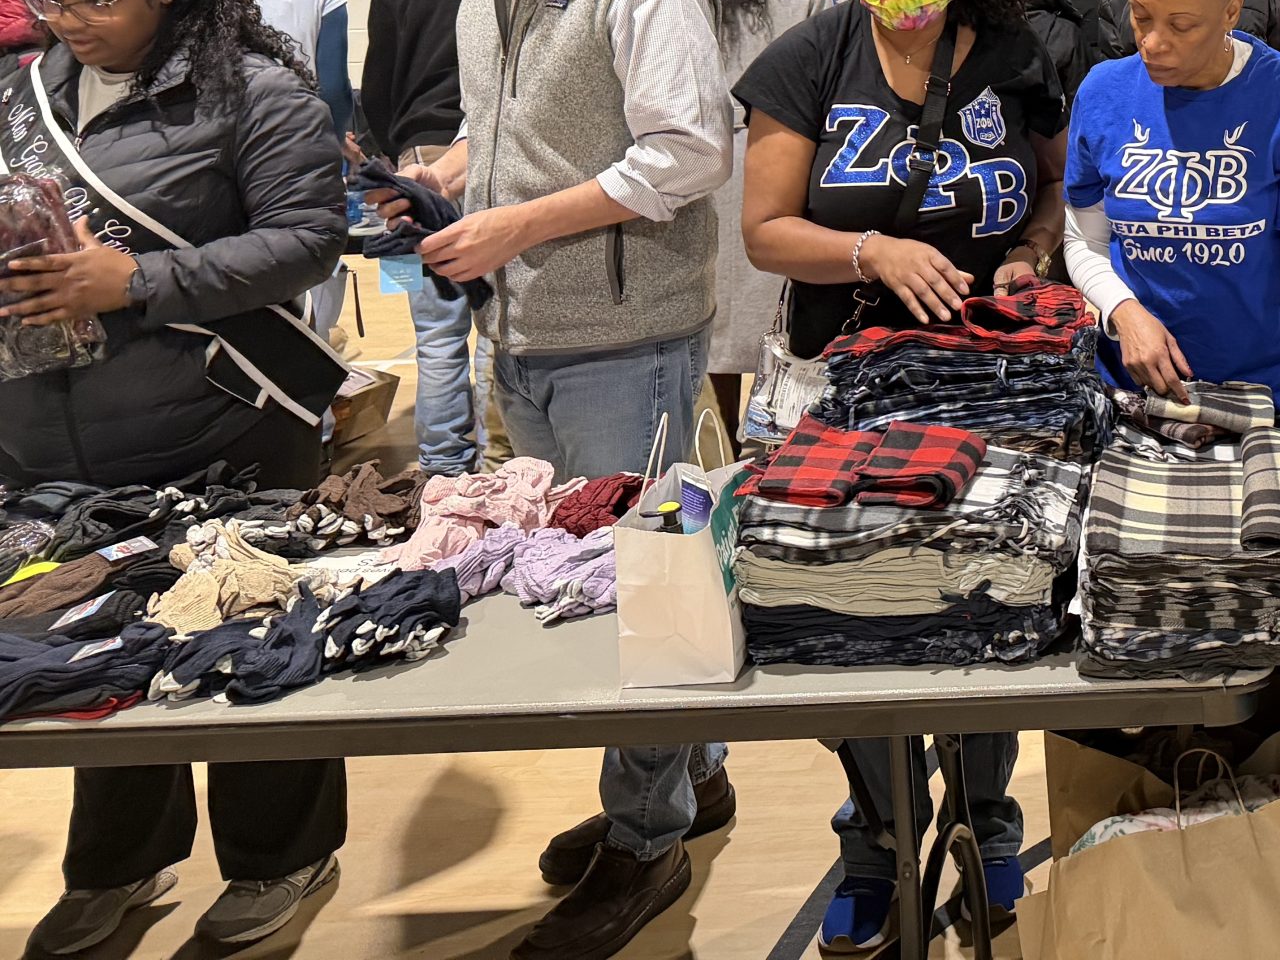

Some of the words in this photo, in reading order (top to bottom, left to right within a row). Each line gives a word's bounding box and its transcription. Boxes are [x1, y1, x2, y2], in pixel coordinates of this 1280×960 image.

[1156, 224, 1199, 237] PHI
[1205, 223, 1263, 238] BETA
[1123, 239, 1177, 264] Since
[1182, 242, 1246, 267] 1920
